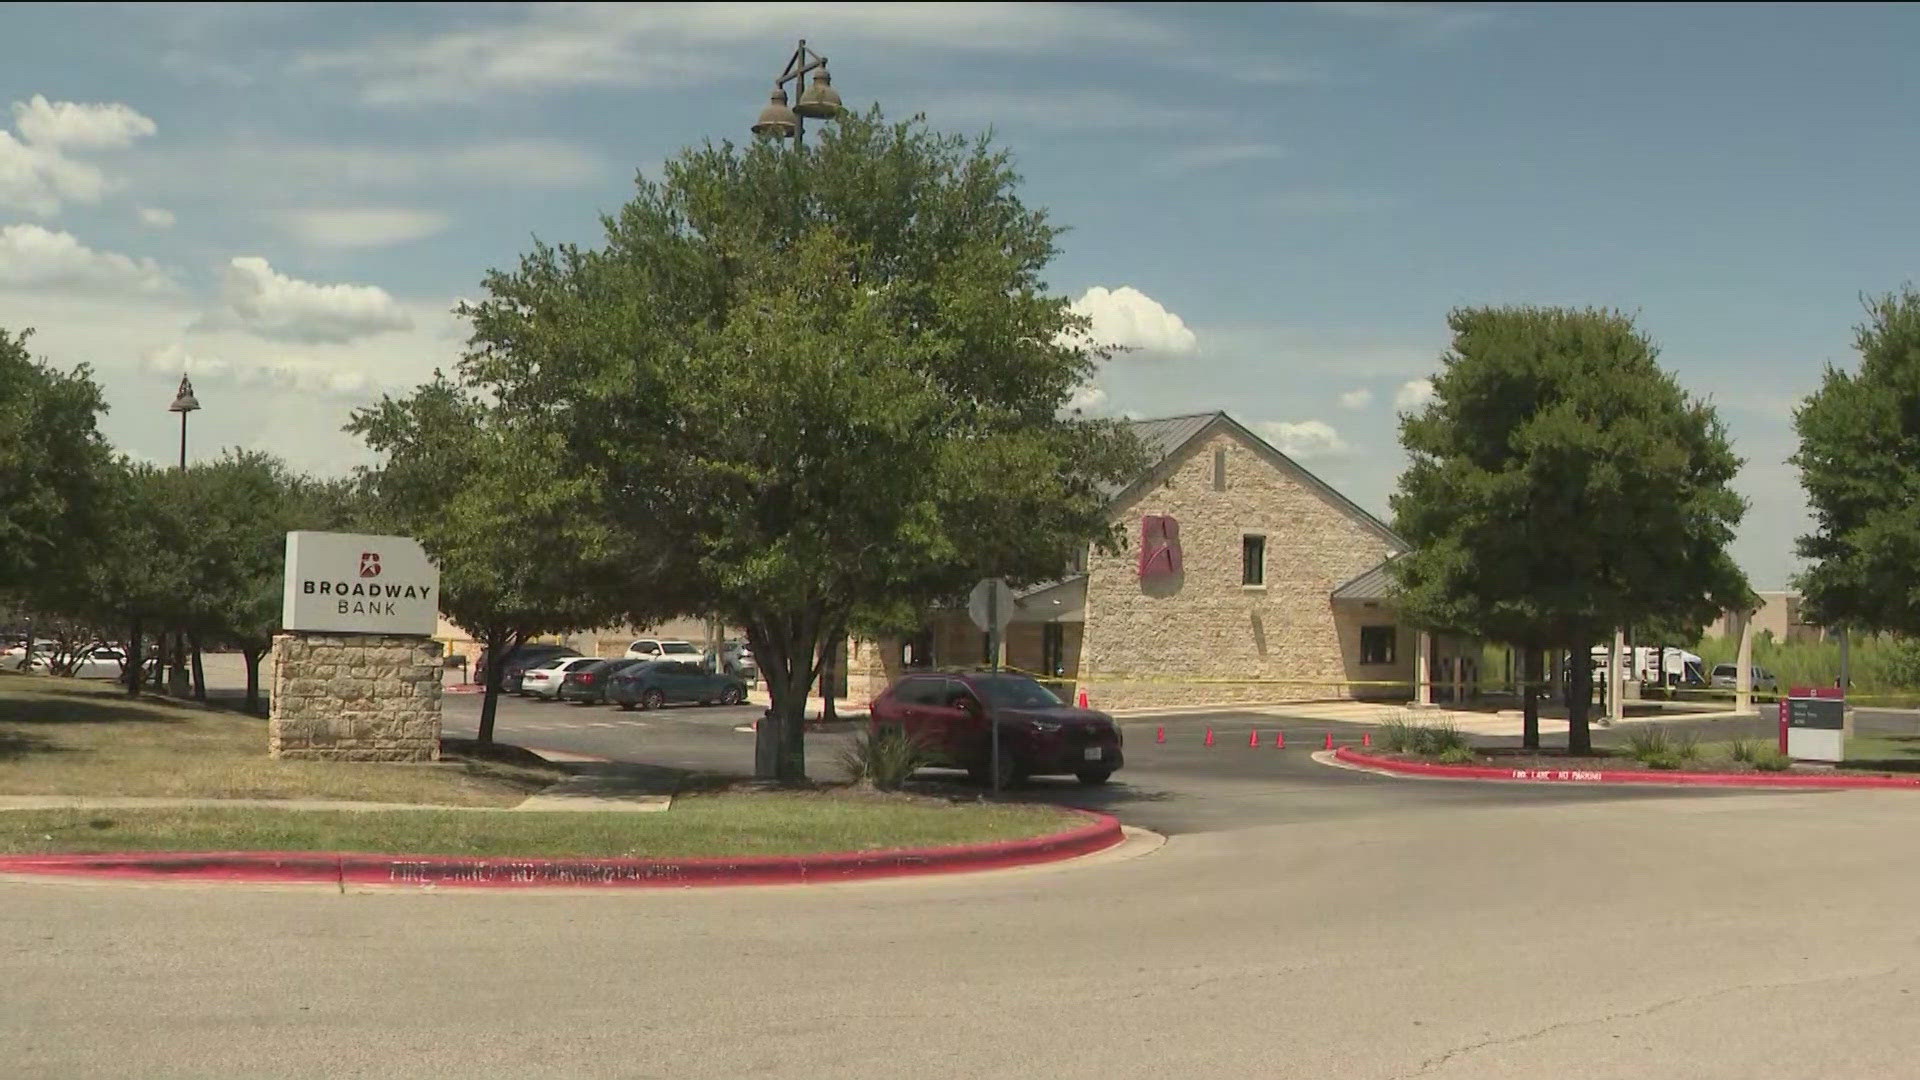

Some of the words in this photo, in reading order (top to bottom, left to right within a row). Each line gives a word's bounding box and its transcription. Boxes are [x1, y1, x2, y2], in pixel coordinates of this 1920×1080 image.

[303, 580, 431, 600] BROADWAY
[338, 599, 397, 616] BANK
[1558, 770, 1569, 781] NO
[390, 860, 432, 882] FIRE
[511, 862, 534, 883] NO
